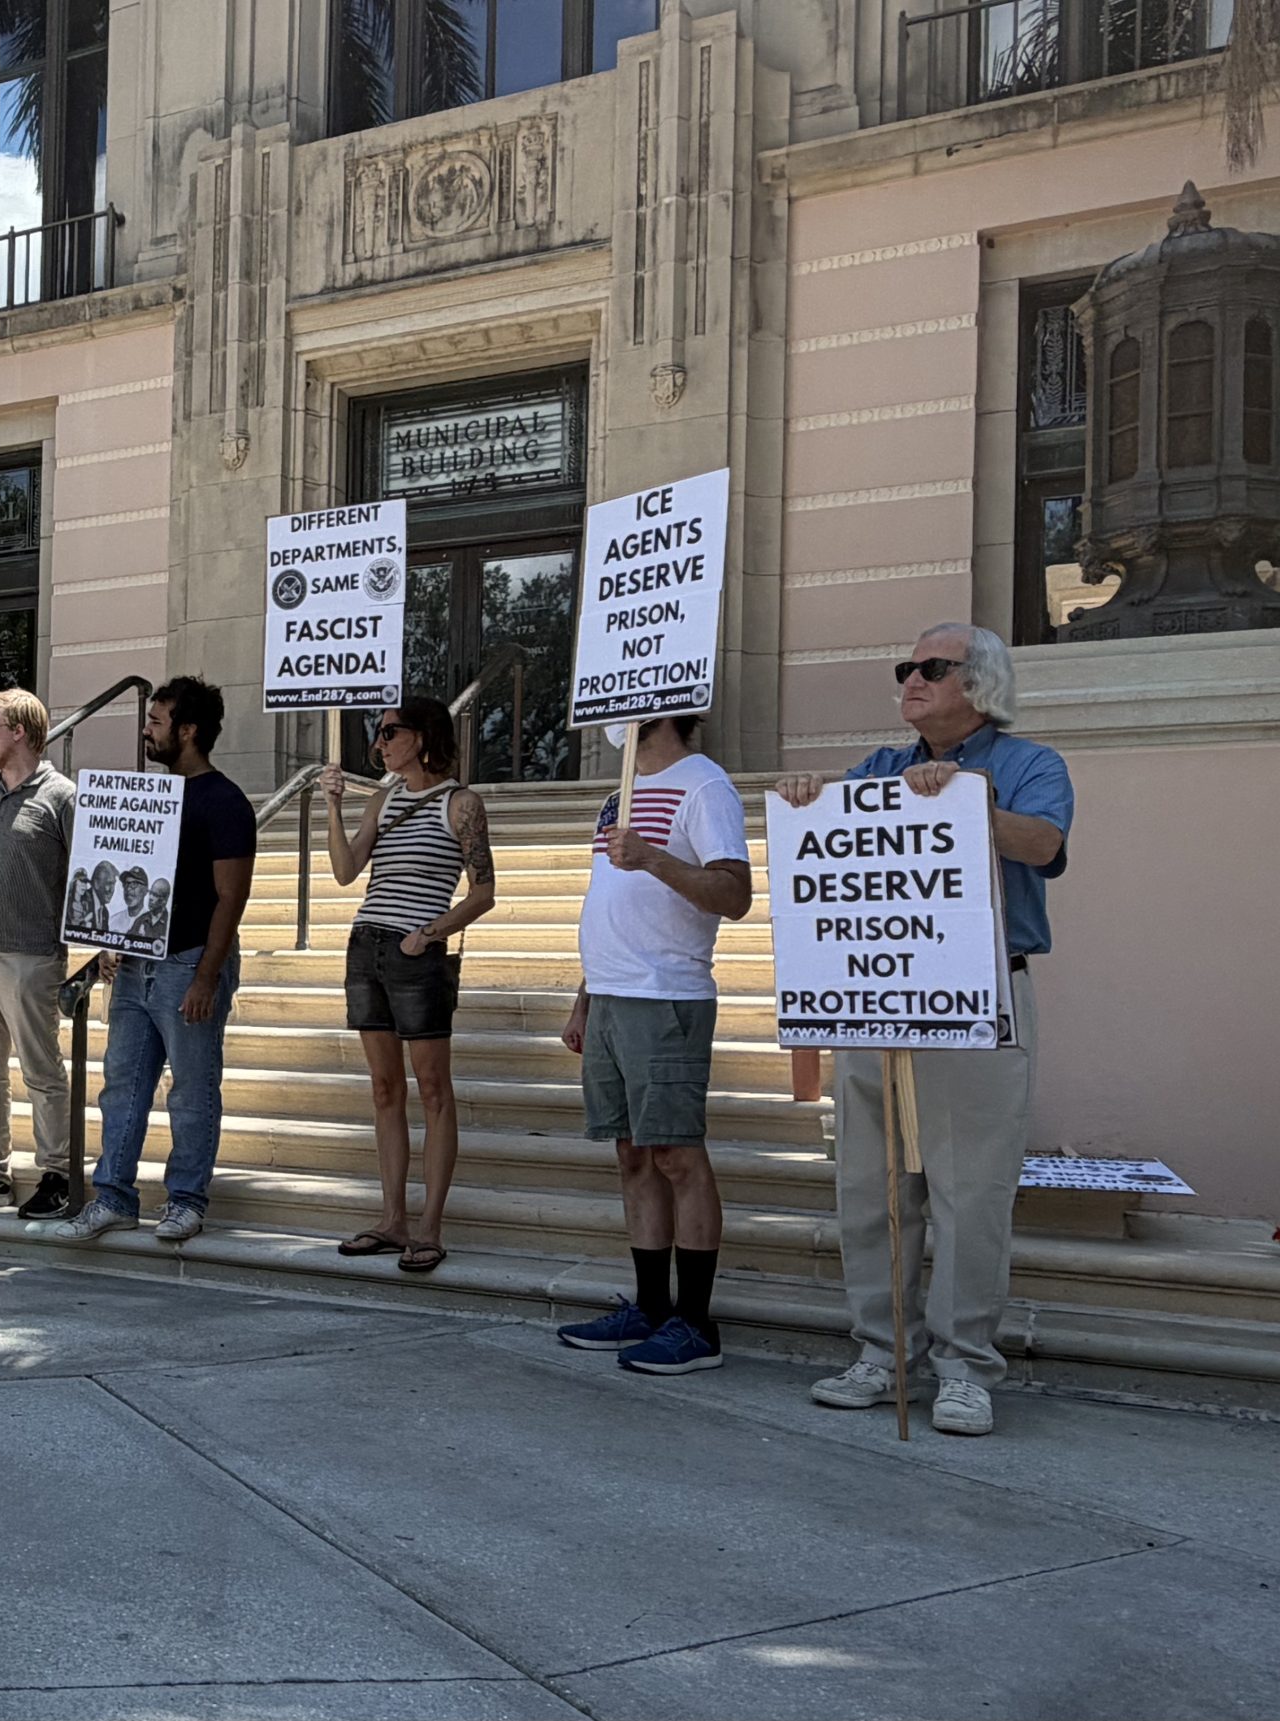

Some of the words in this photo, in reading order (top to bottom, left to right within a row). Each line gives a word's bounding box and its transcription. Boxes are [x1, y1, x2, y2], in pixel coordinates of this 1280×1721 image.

[395, 412, 547, 452] MUNICIPAL
[401, 439, 541, 478] BUILDING
[451, 472, 497, 497] 175
[636, 487, 673, 520] ICE
[291, 504, 381, 532] DIFFERENT
[270, 536, 402, 567] DEPARTMENTS,
[603, 517, 702, 565] AGENTS
[311, 574, 359, 594] SAME
[599, 555, 705, 601] DESERVE
[285, 615, 382, 642] FASCIST
[606, 600, 685, 633] PRISON,
[622, 634, 664, 660] NOT
[277, 650, 386, 678] AGENDA!
[578, 658, 708, 697] PROTECTION!
[267, 691, 381, 704] www.End287g.com
[575, 692, 691, 716] www.End287g.com
[89, 774, 154, 792] PARTNERS
[158, 779, 172, 793] IN
[843, 780, 901, 813] ICE
[79, 794, 117, 810] CRIME
[119, 797, 179, 815] AGAINST
[89, 814, 164, 835] IMMIGRANT
[93, 835, 154, 855] FAMILIES!
[796, 822, 955, 860] AGENTS
[793, 868, 963, 903] DESERVE
[64, 928, 151, 950] www.End287g.com
[816, 915, 945, 944] PRISON,
[848, 953, 914, 977] NOT
[781, 990, 989, 1015] PROTECTION!
[780, 1023, 967, 1043] www.End287g.com
